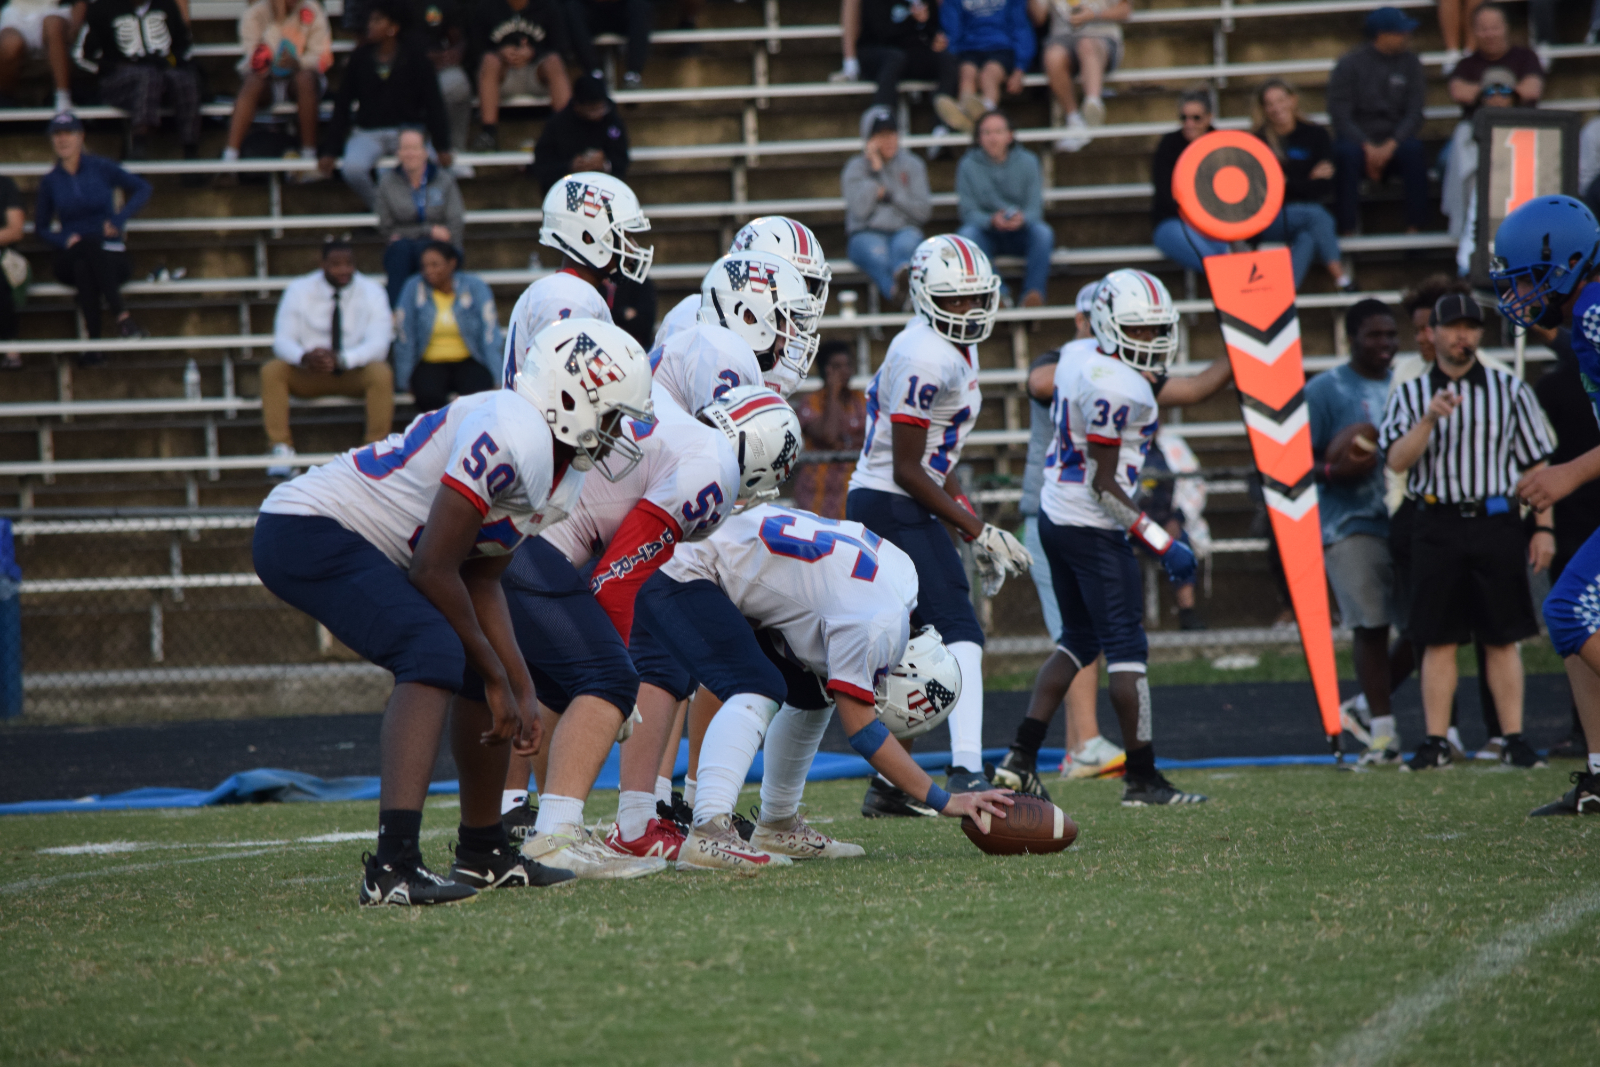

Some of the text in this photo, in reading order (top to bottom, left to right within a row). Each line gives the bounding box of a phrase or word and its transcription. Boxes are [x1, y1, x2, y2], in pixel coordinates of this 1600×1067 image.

[1504, 128, 1538, 217] 1
[566, 181, 615, 218] W
[724, 260, 779, 293] W
[564, 332, 626, 390] W
[1091, 398, 1130, 431] 34
[463, 431, 515, 498] 50
